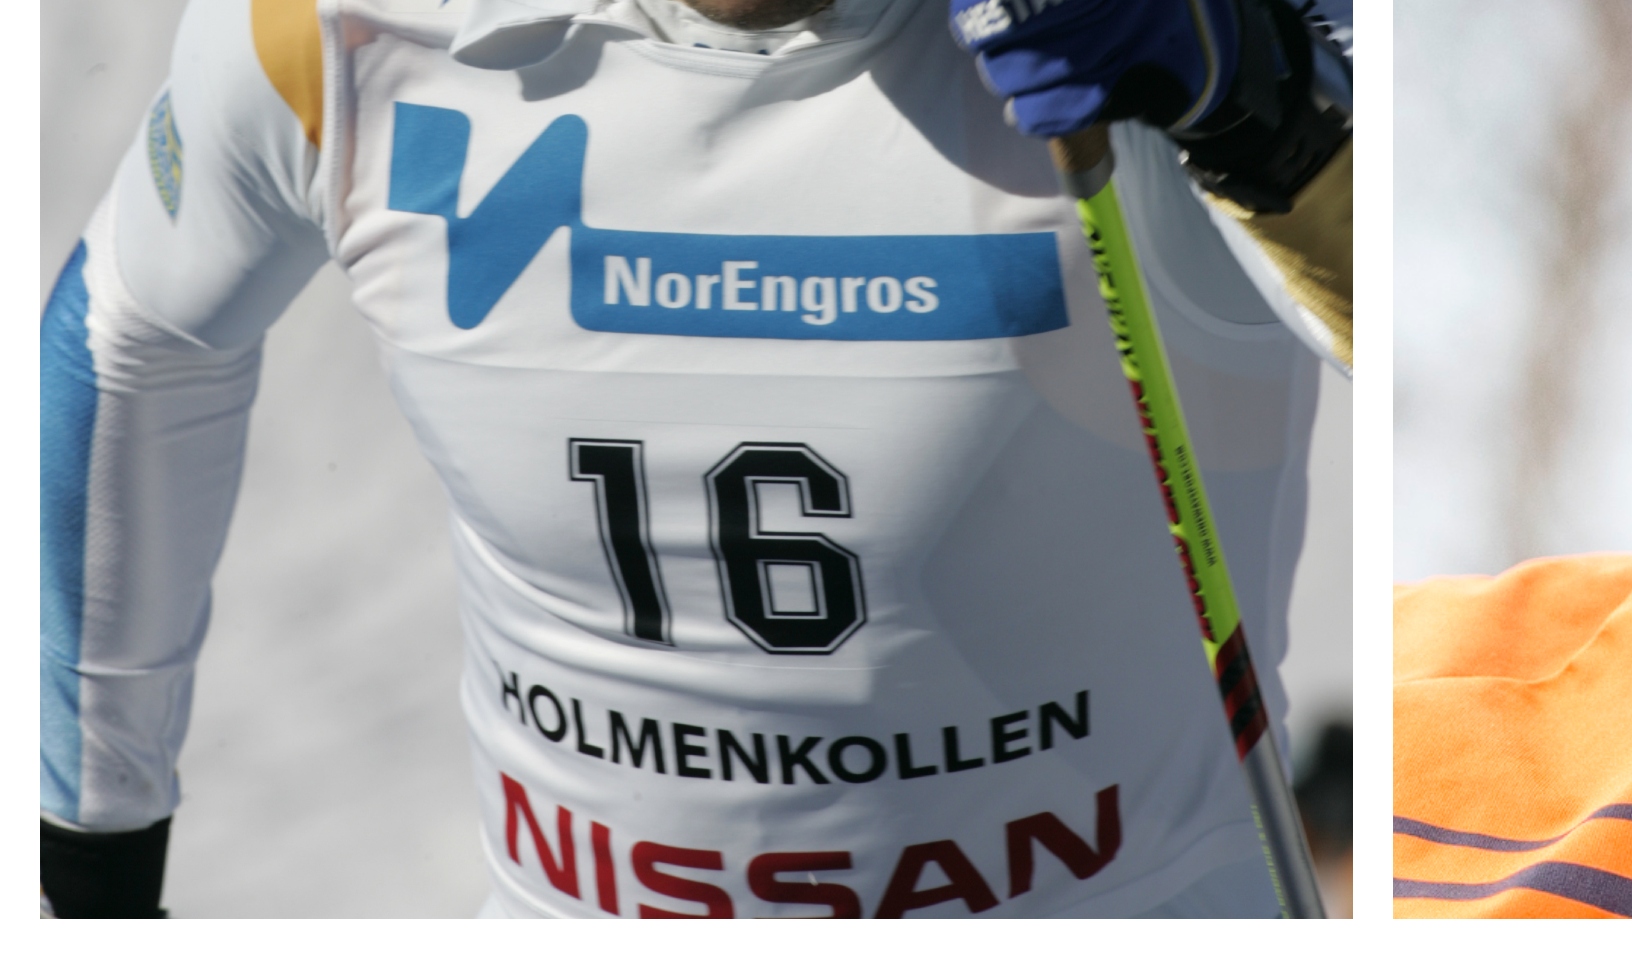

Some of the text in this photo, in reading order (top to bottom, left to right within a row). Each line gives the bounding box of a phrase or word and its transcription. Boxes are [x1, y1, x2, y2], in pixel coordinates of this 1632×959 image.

[604, 255, 938, 325] NorEngros
[568, 437, 868, 656] 16
[502, 671, 1091, 785] HOLMENKOLLEN
[499, 771, 1122, 920] NISSAN
